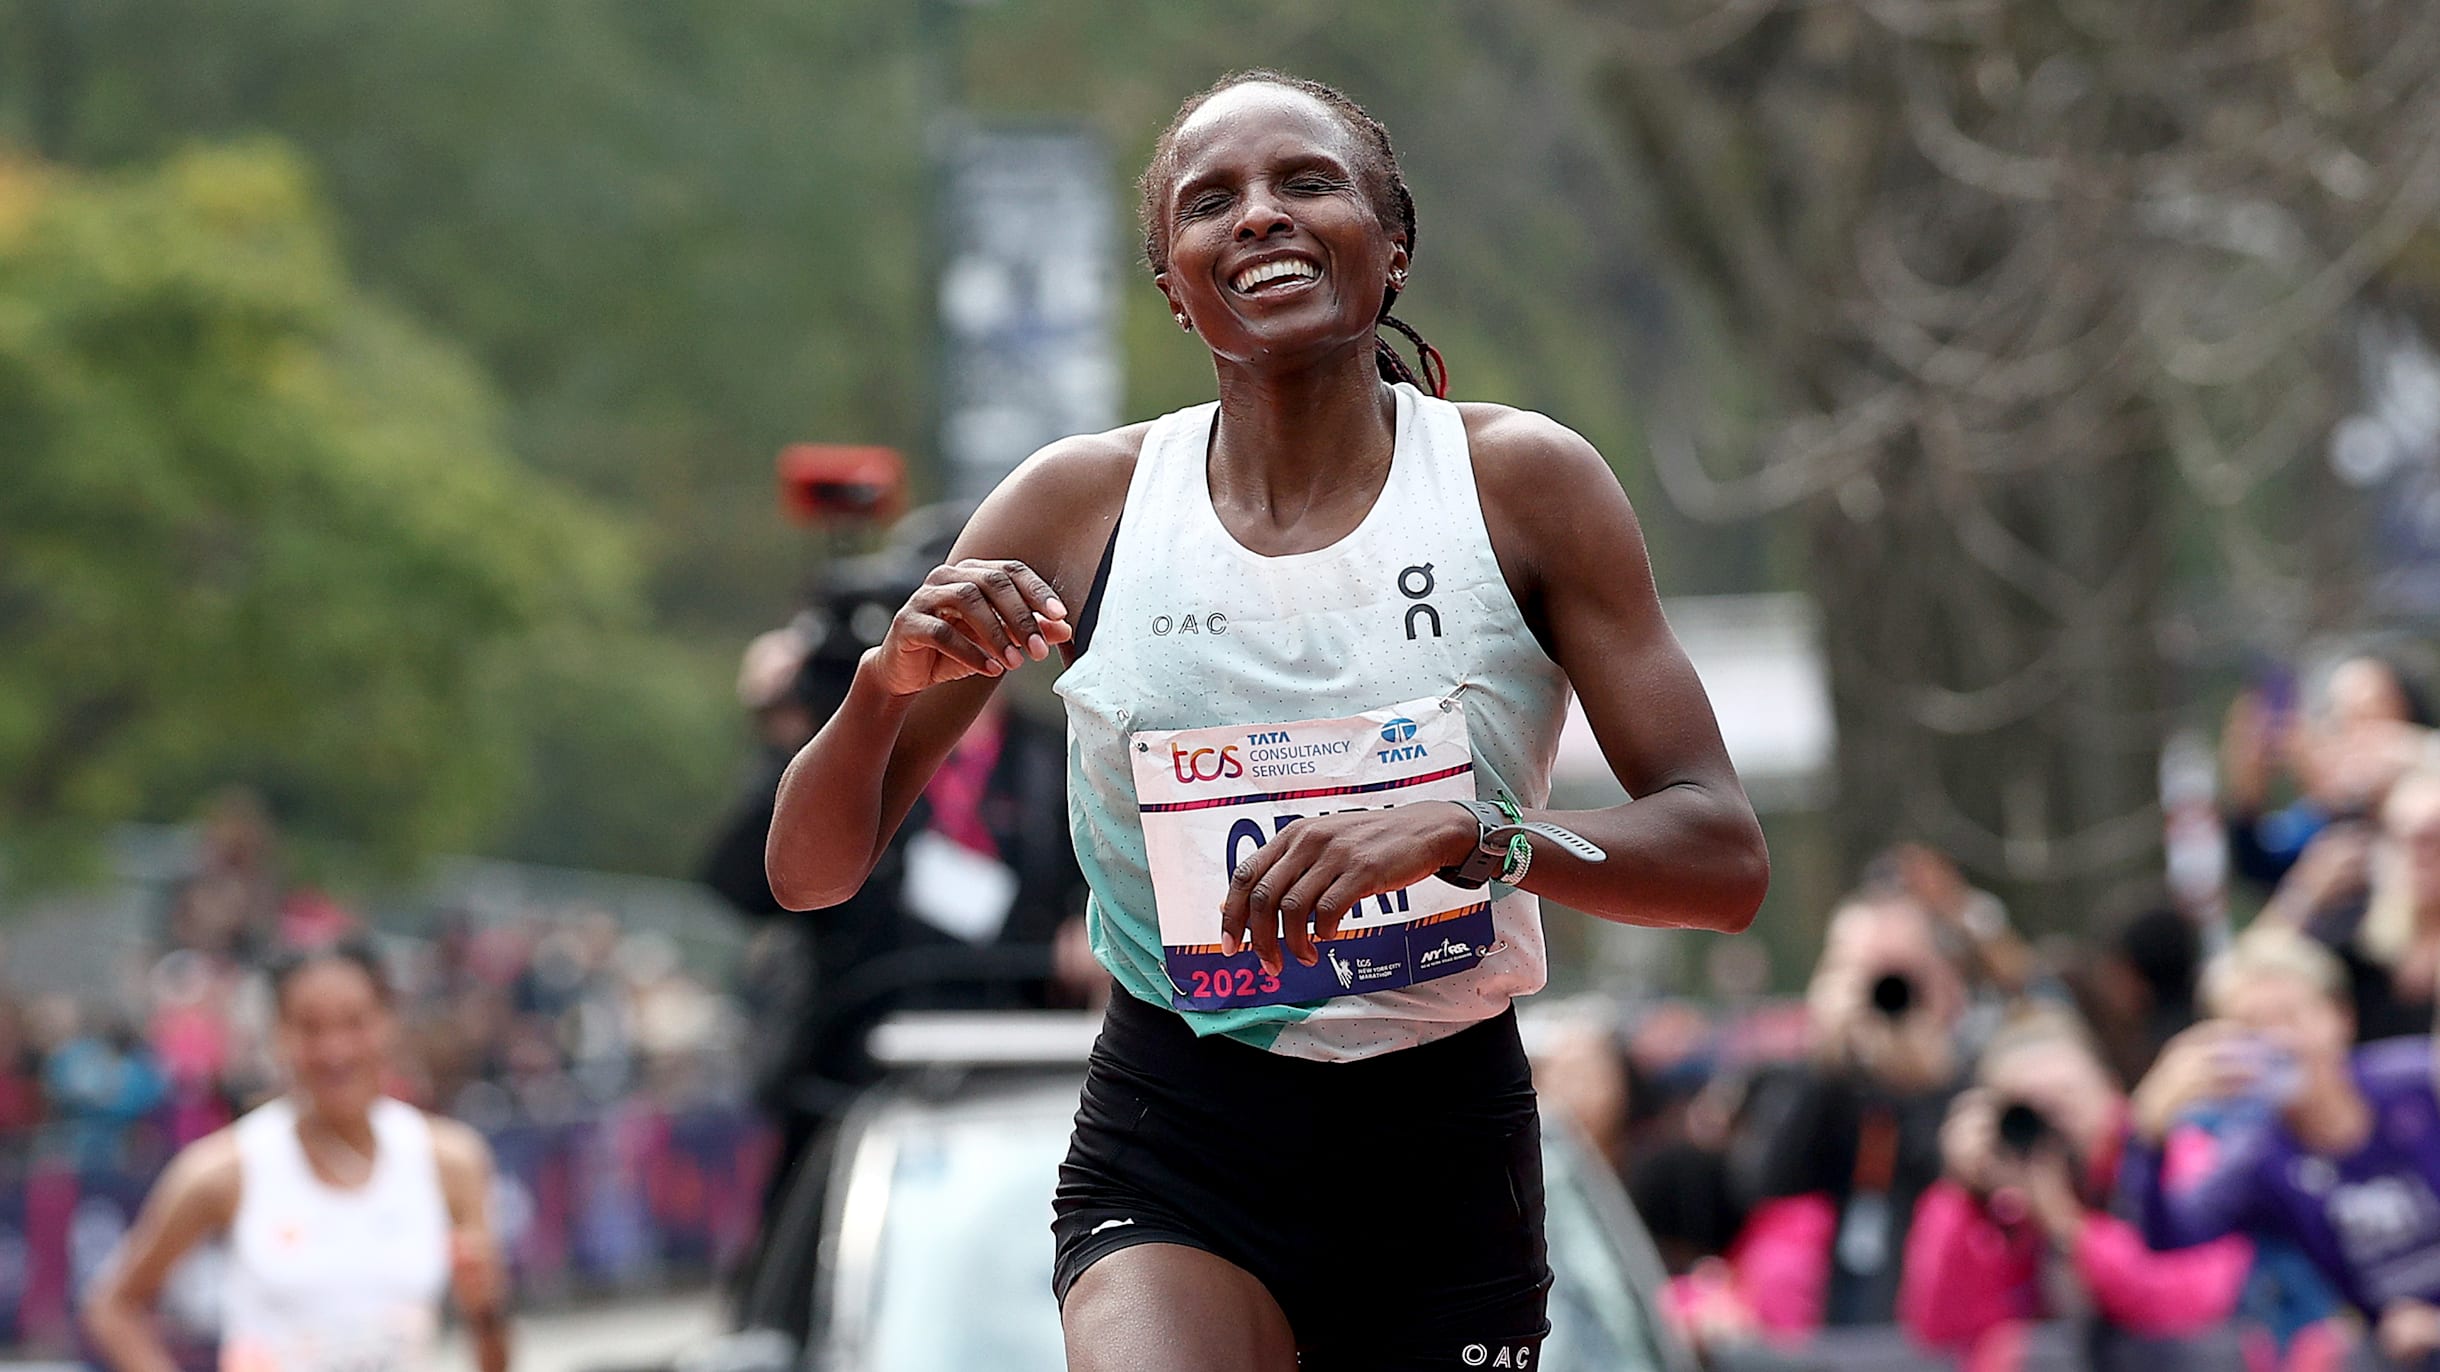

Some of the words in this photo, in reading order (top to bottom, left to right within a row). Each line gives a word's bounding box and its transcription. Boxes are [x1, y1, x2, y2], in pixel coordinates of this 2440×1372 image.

[1247, 731, 1291, 746] TATA
[1250, 740, 1351, 762] CONSULTANCY
[1377, 744, 1429, 764] TATA
[1171, 742, 1243, 784] tcs
[1252, 761, 1316, 778] SERVICES
[1191, 968, 1281, 998] 2023
